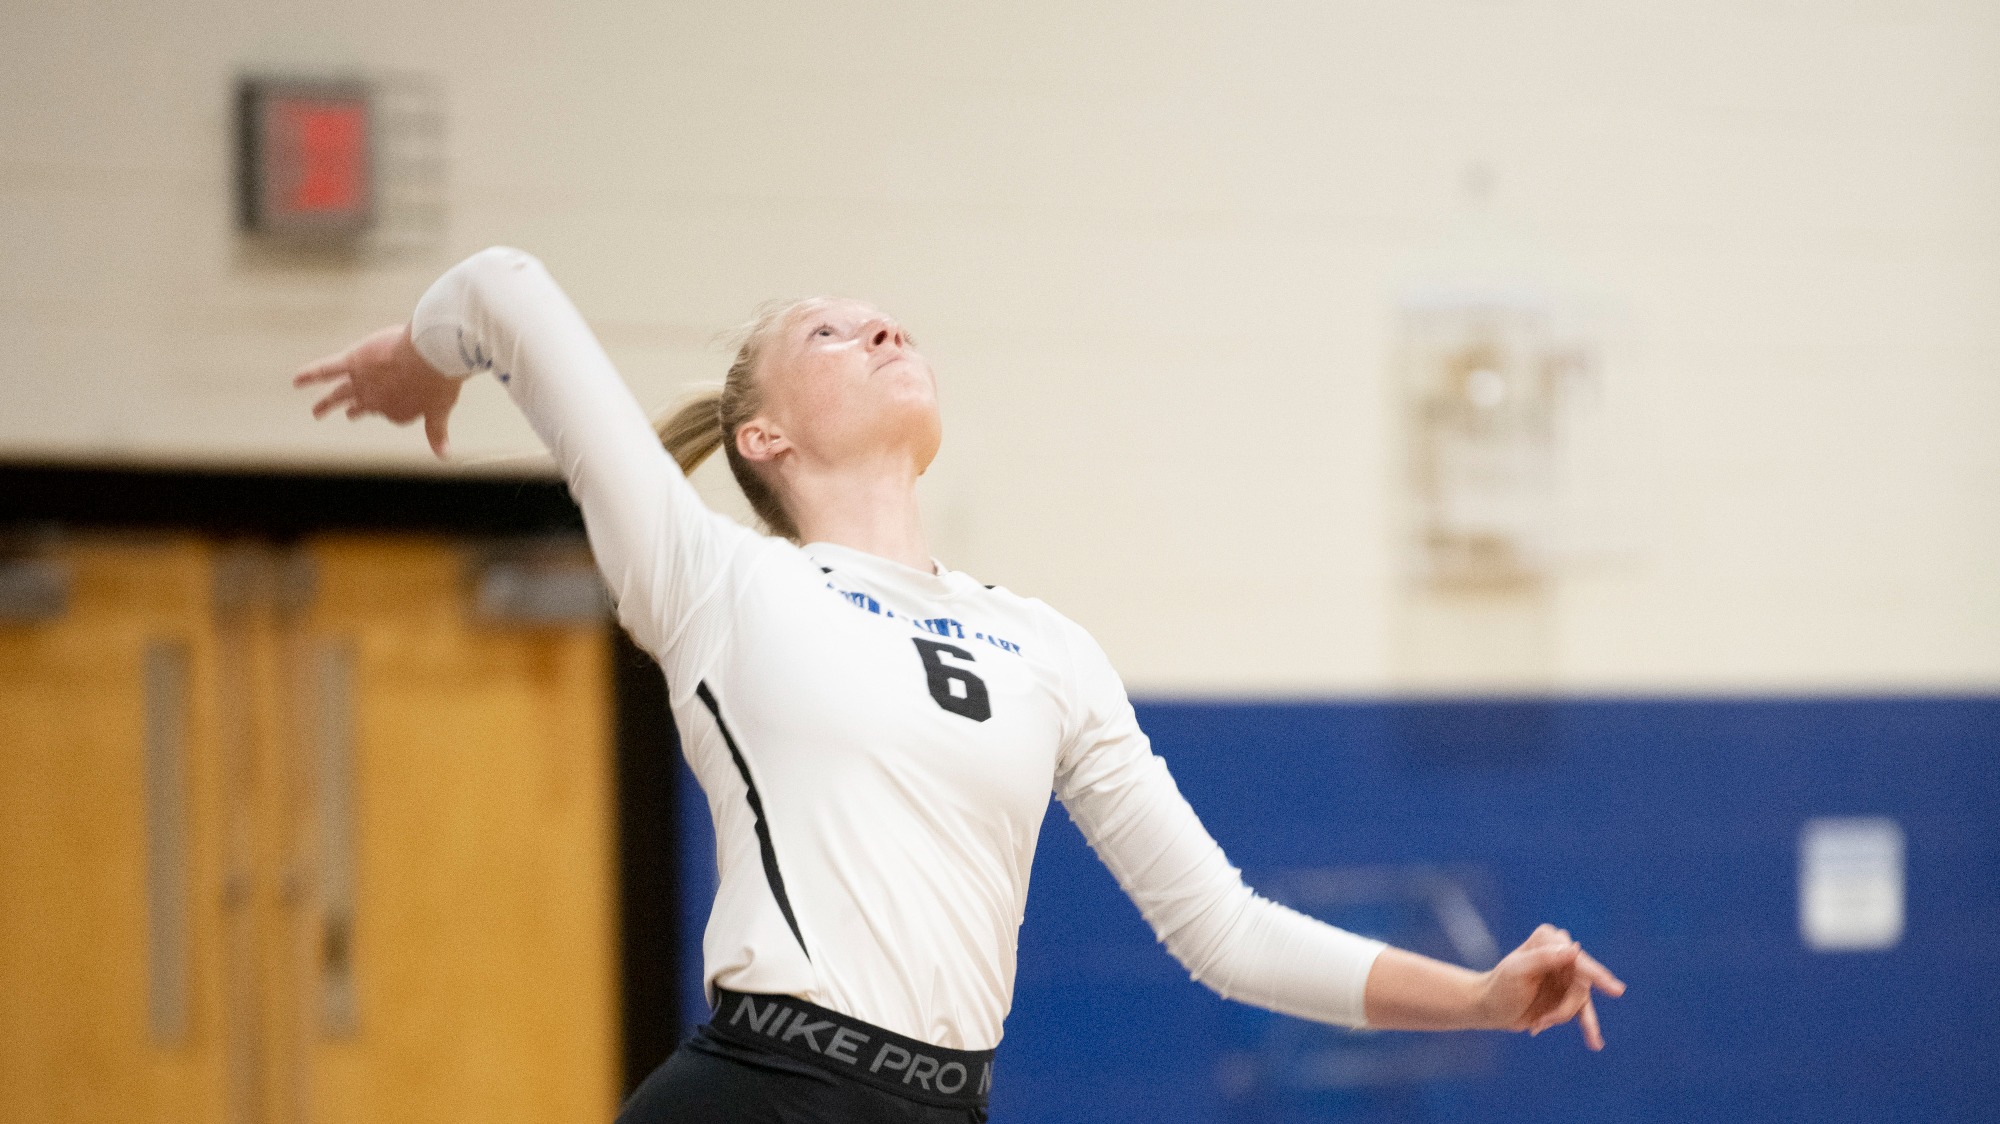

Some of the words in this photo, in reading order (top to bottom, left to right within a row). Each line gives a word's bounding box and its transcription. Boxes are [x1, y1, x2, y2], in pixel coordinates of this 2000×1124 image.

[911, 637, 992, 722] 6
[729, 995, 870, 1065] NIKE
[869, 1043, 968, 1095] PRO
